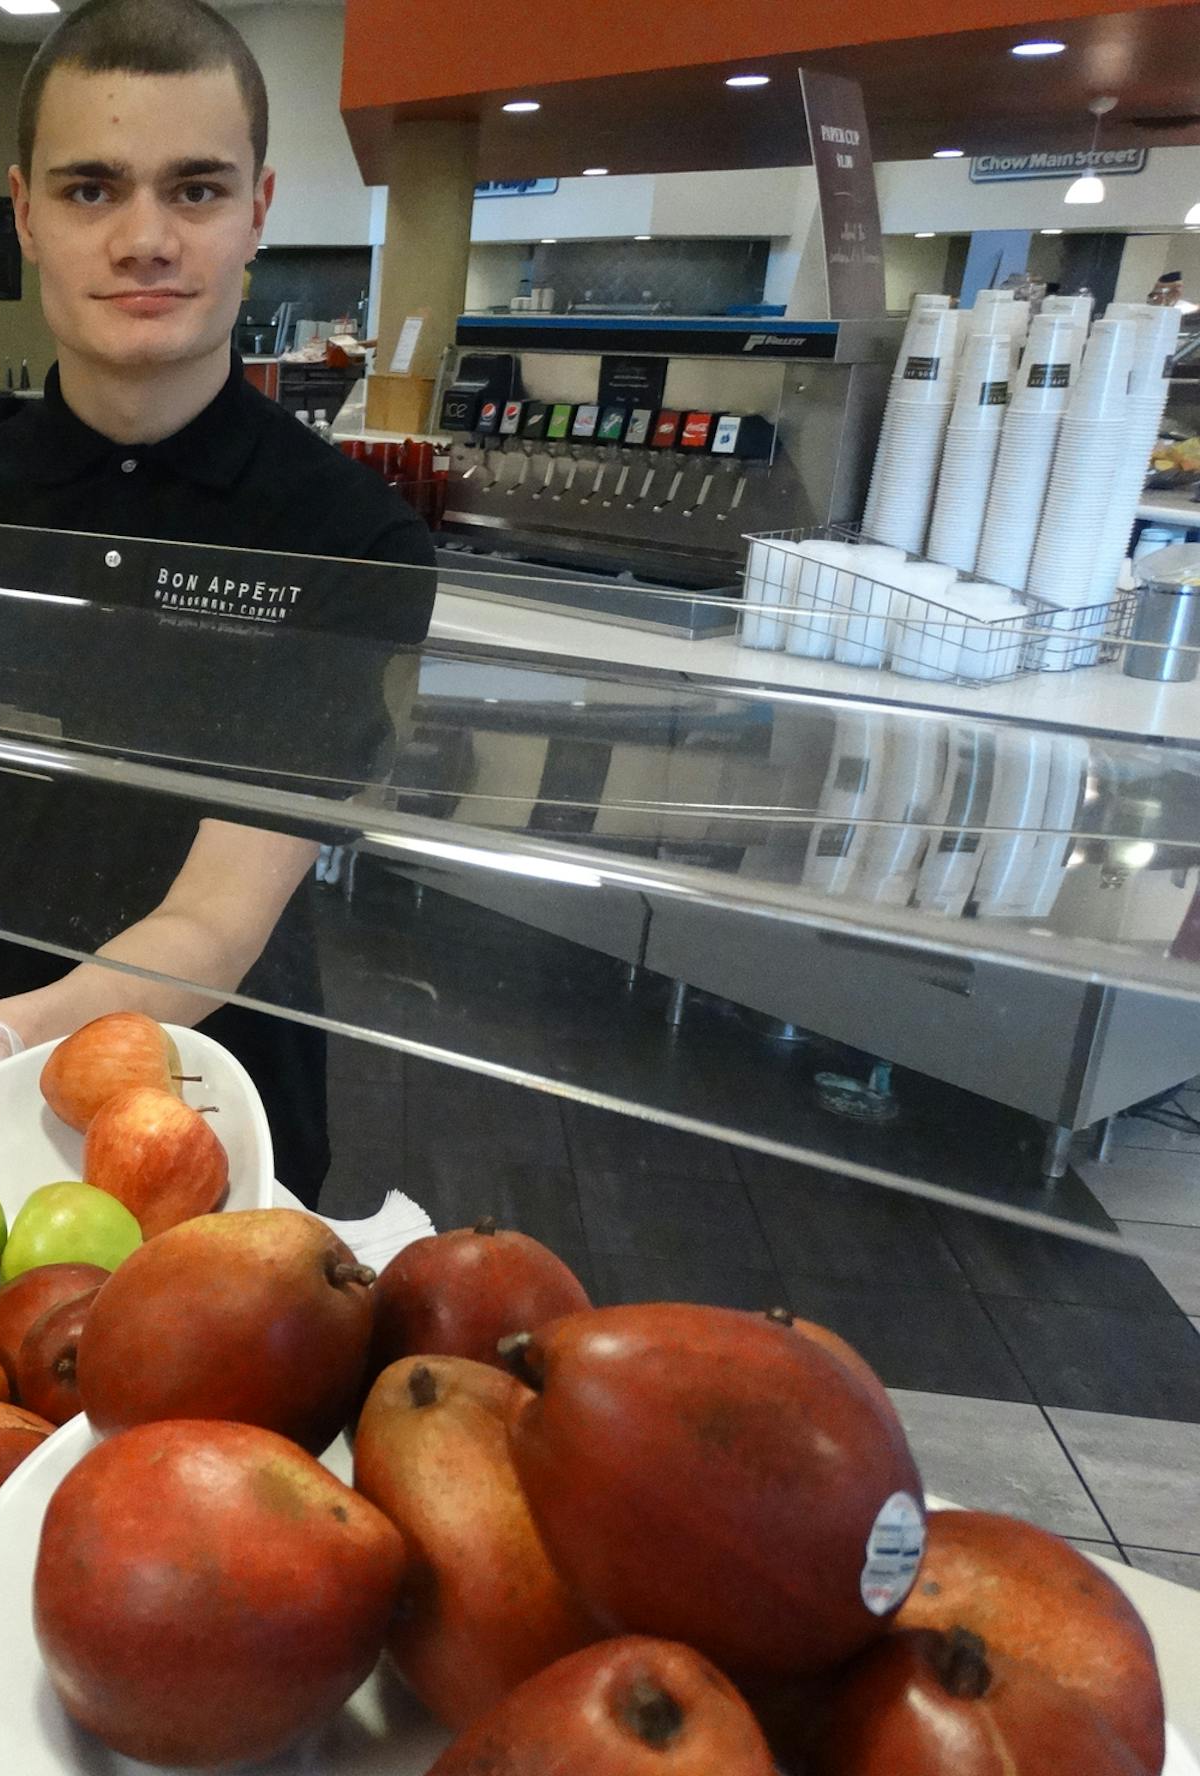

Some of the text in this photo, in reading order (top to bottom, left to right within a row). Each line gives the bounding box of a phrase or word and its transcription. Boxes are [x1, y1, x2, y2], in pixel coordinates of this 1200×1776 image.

[977, 155, 1027, 172] Chow
[157, 567, 199, 592] BON
[240, 604, 293, 619] COMPAN
